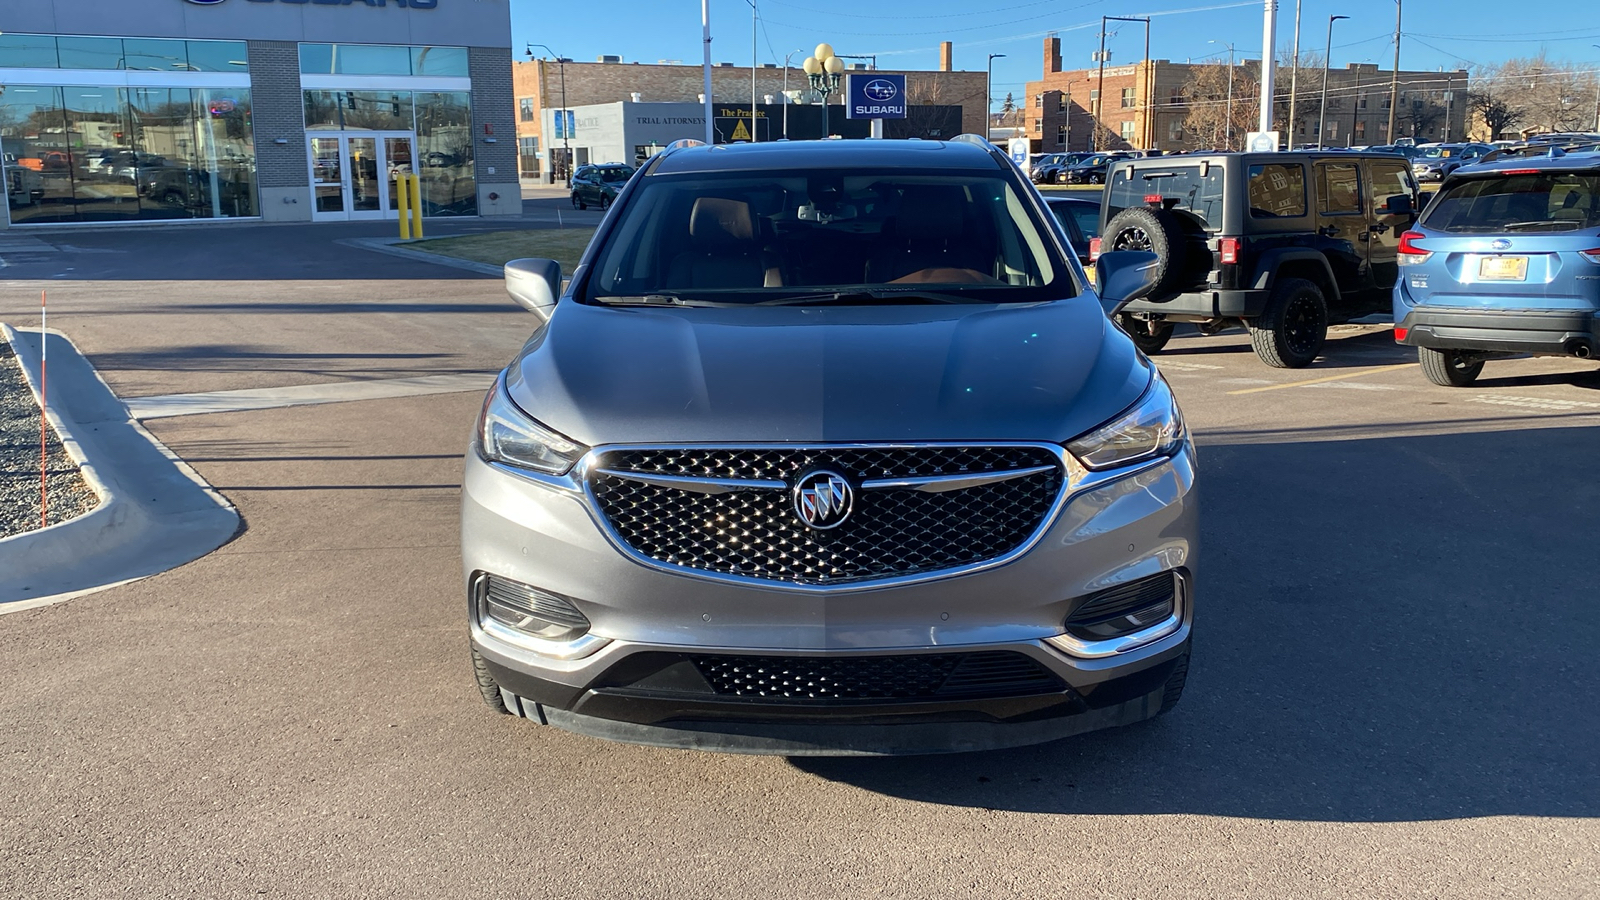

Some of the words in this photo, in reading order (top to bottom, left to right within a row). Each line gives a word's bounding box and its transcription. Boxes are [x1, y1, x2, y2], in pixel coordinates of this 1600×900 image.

[736, 109, 765, 117] Pracice
[856, 106, 902, 114] SUBARU
[637, 117, 661, 125] TRIAL
[663, 117, 706, 125] ATTORNEYS
